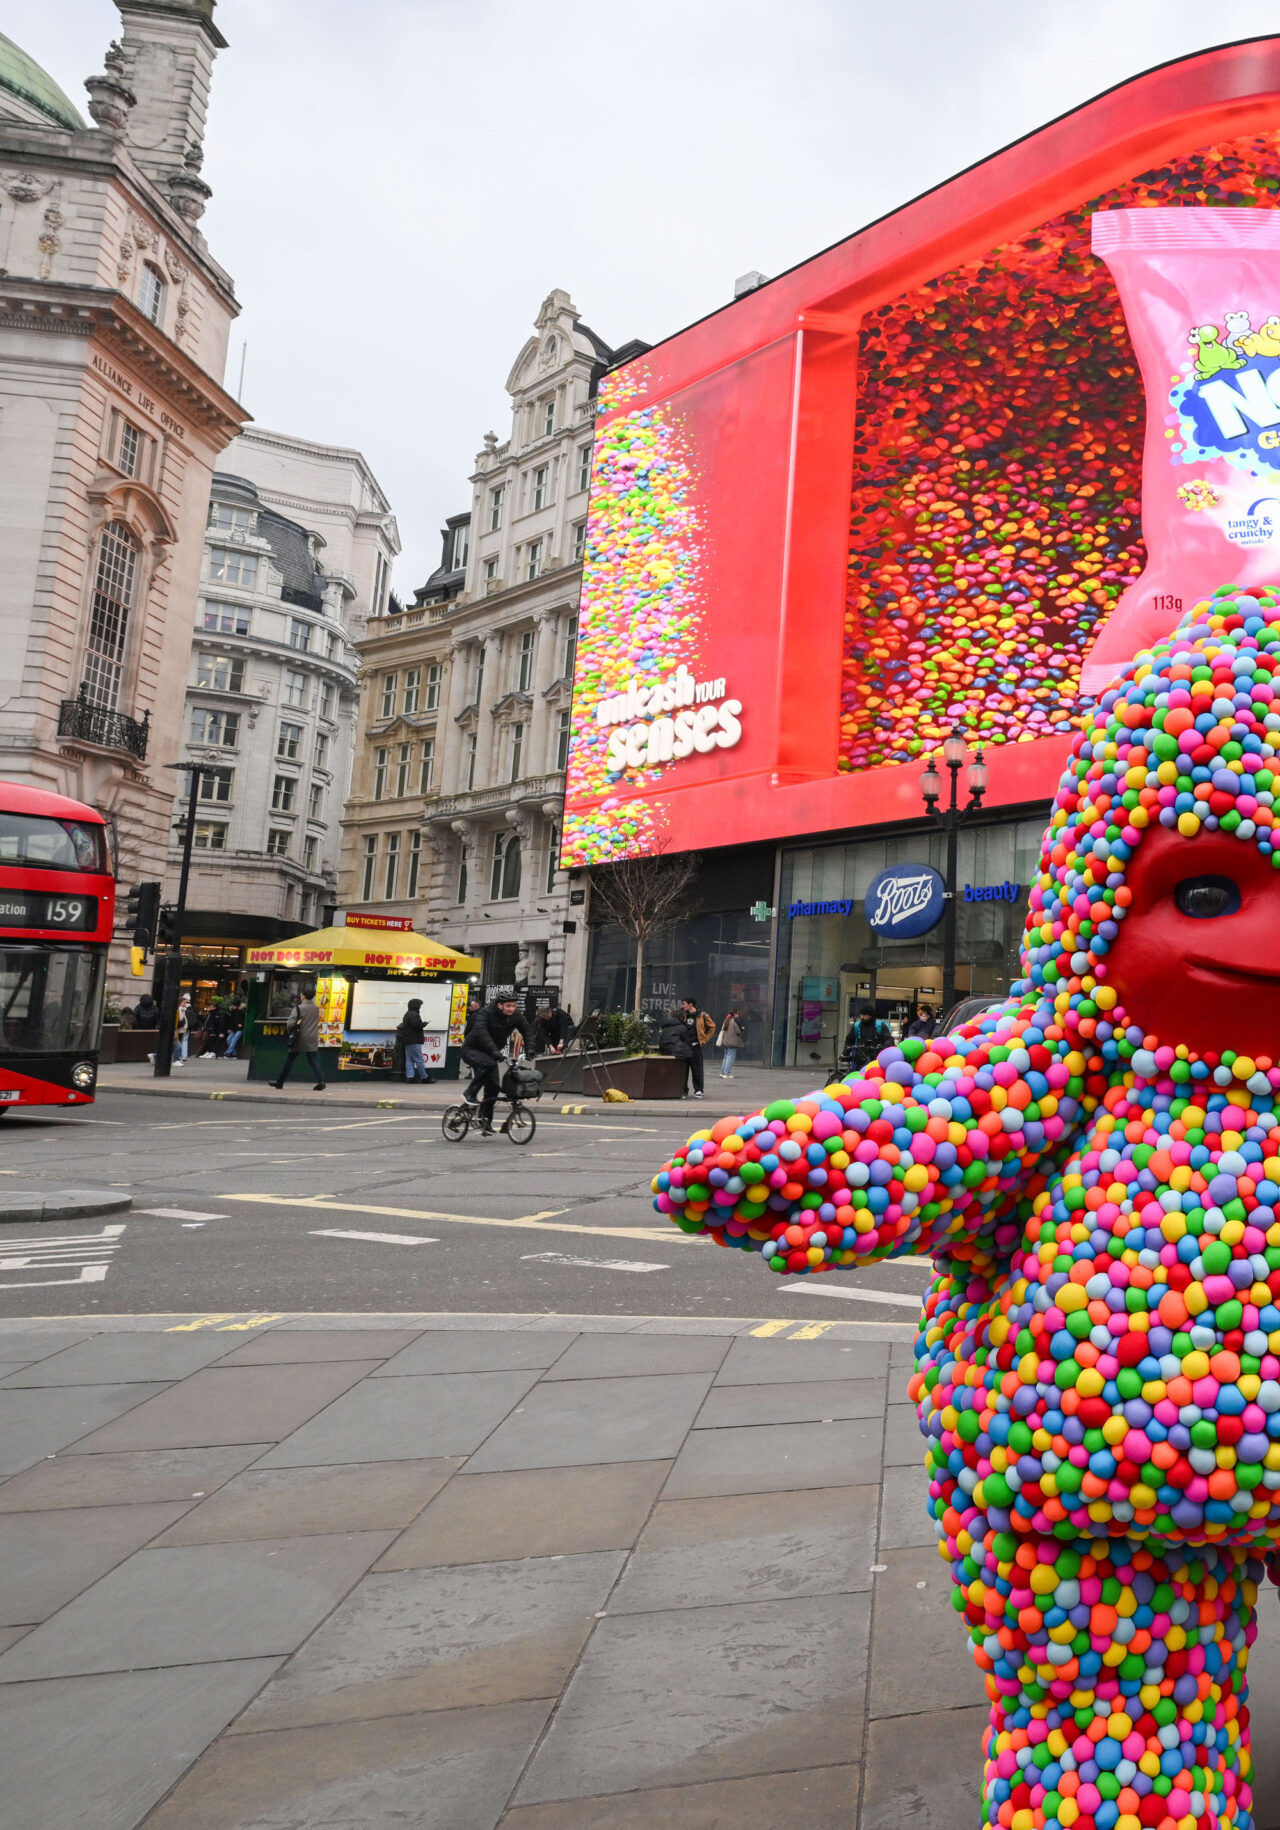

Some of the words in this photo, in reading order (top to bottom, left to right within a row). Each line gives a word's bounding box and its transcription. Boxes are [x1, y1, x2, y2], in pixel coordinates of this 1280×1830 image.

[92, 355, 132, 395] ALLIANCE
[138, 392, 155, 415] LIFE
[160, 412, 185, 439] OFFICE
[1228, 518, 1259, 530] tangy
[1263, 516, 1272, 526] &
[1228, 527, 1274, 540] crunchy
[1152, 595, 1182, 613] 113g
[695, 677, 726, 703] YOUR
[607, 699, 742, 772] senses
[964, 880, 1020, 903] beauty
[870, 874, 933, 926] Boots
[0, 903, 26, 916] ation
[47, 900, 82, 922] 159
[788, 899, 854, 919] pharmacy
[346, 916, 360, 924] BUY
[360, 917, 386, 926] TICKETS
[250, 951, 274, 961] HOT
[277, 951, 301, 961] DOG
[303, 951, 333, 961] SPOT
[365, 953, 392, 964] HOT
[395, 955, 422, 967] DOG
[425, 957, 456, 968] SPOT
[387, 968, 401, 976] HOT
[652, 982, 676, 995] LIVE
[263, 1025, 286, 1036] HOT
